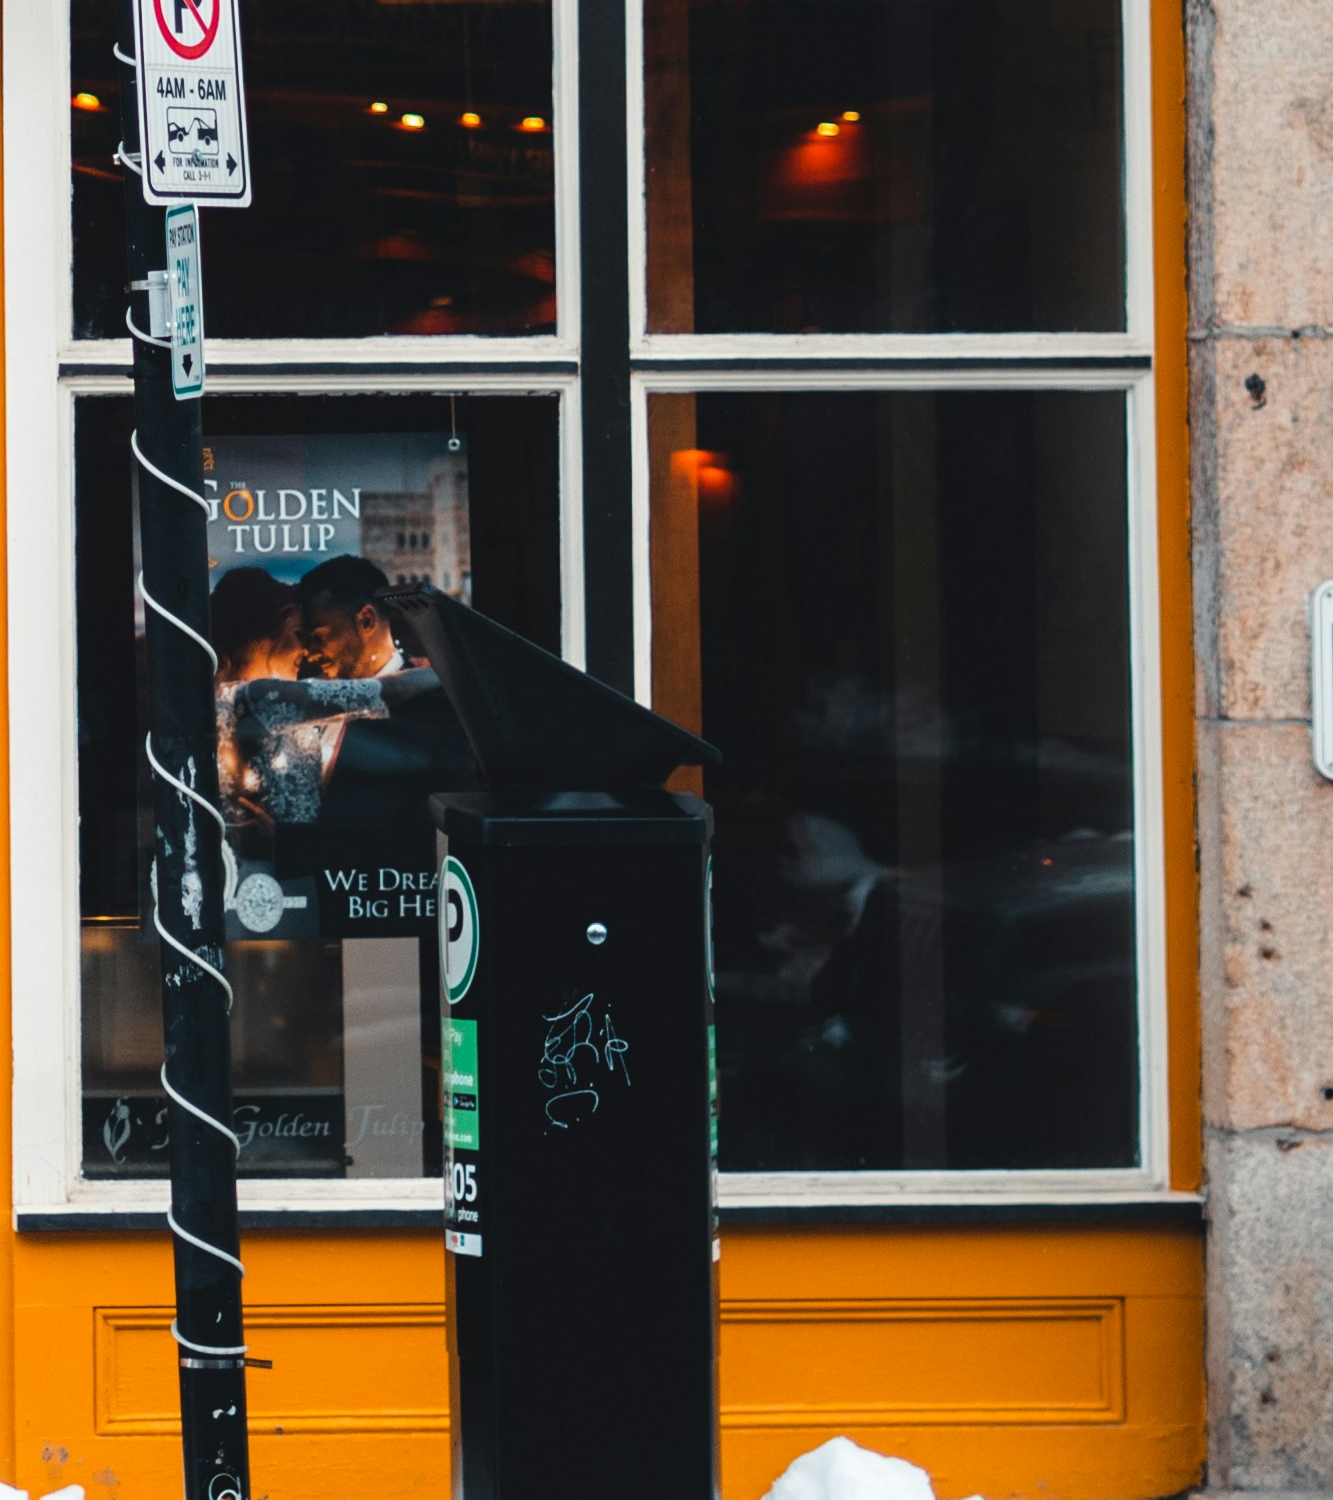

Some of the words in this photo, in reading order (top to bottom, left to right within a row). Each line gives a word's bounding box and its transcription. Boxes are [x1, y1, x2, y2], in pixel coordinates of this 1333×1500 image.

[156, 76, 186, 99] 4AM
[197, 78, 227, 101] 6AM
[183, 170, 196, 181] CALL
[177, 223, 195, 247] STATION
[176, 257, 190, 298] PAY
[175, 304, 196, 347] HERE
[227, 524, 335, 553] TULIP
